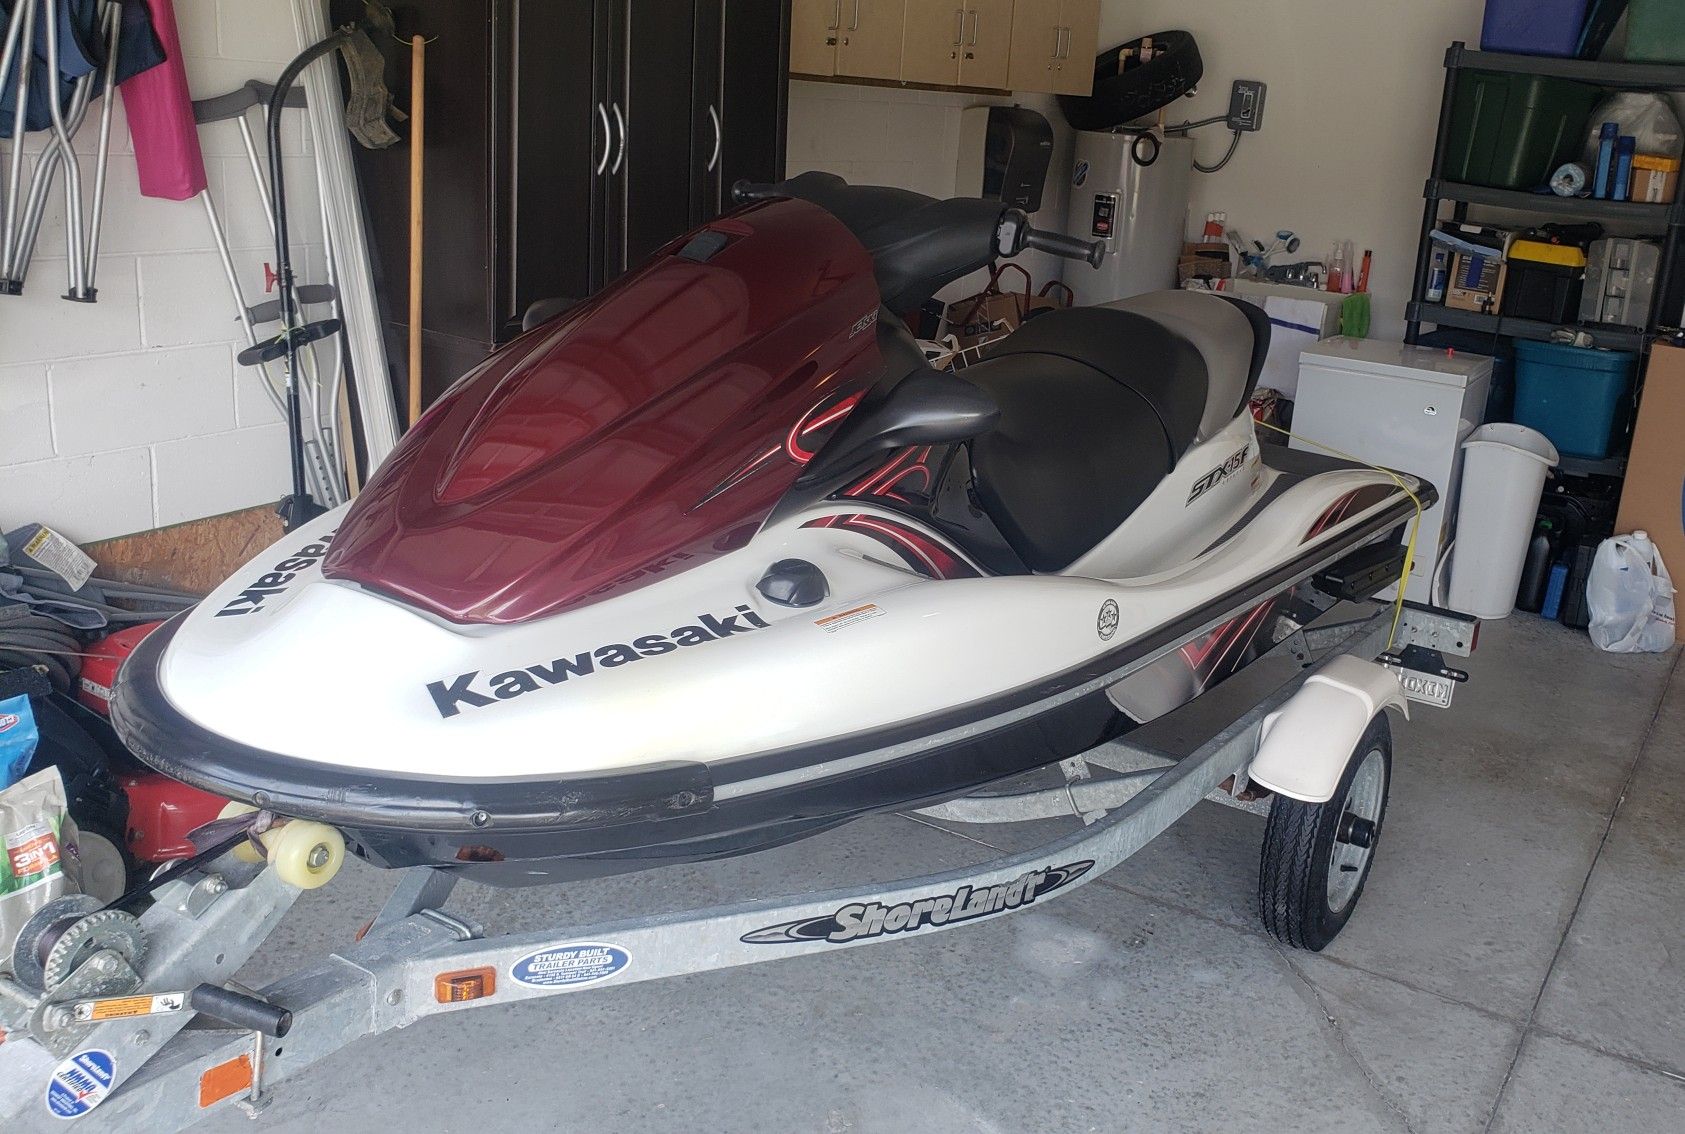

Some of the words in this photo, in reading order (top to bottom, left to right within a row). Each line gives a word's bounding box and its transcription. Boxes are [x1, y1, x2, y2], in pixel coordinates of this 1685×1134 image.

[214, 528, 337, 617] asaki
[426, 605, 771, 718] Kawasaki
[532, 961, 576, 970] TRAILER
[577, 957, 609, 966] PARTS
[534, 951, 578, 963] STURDY
[579, 948, 610, 959] BUILT
